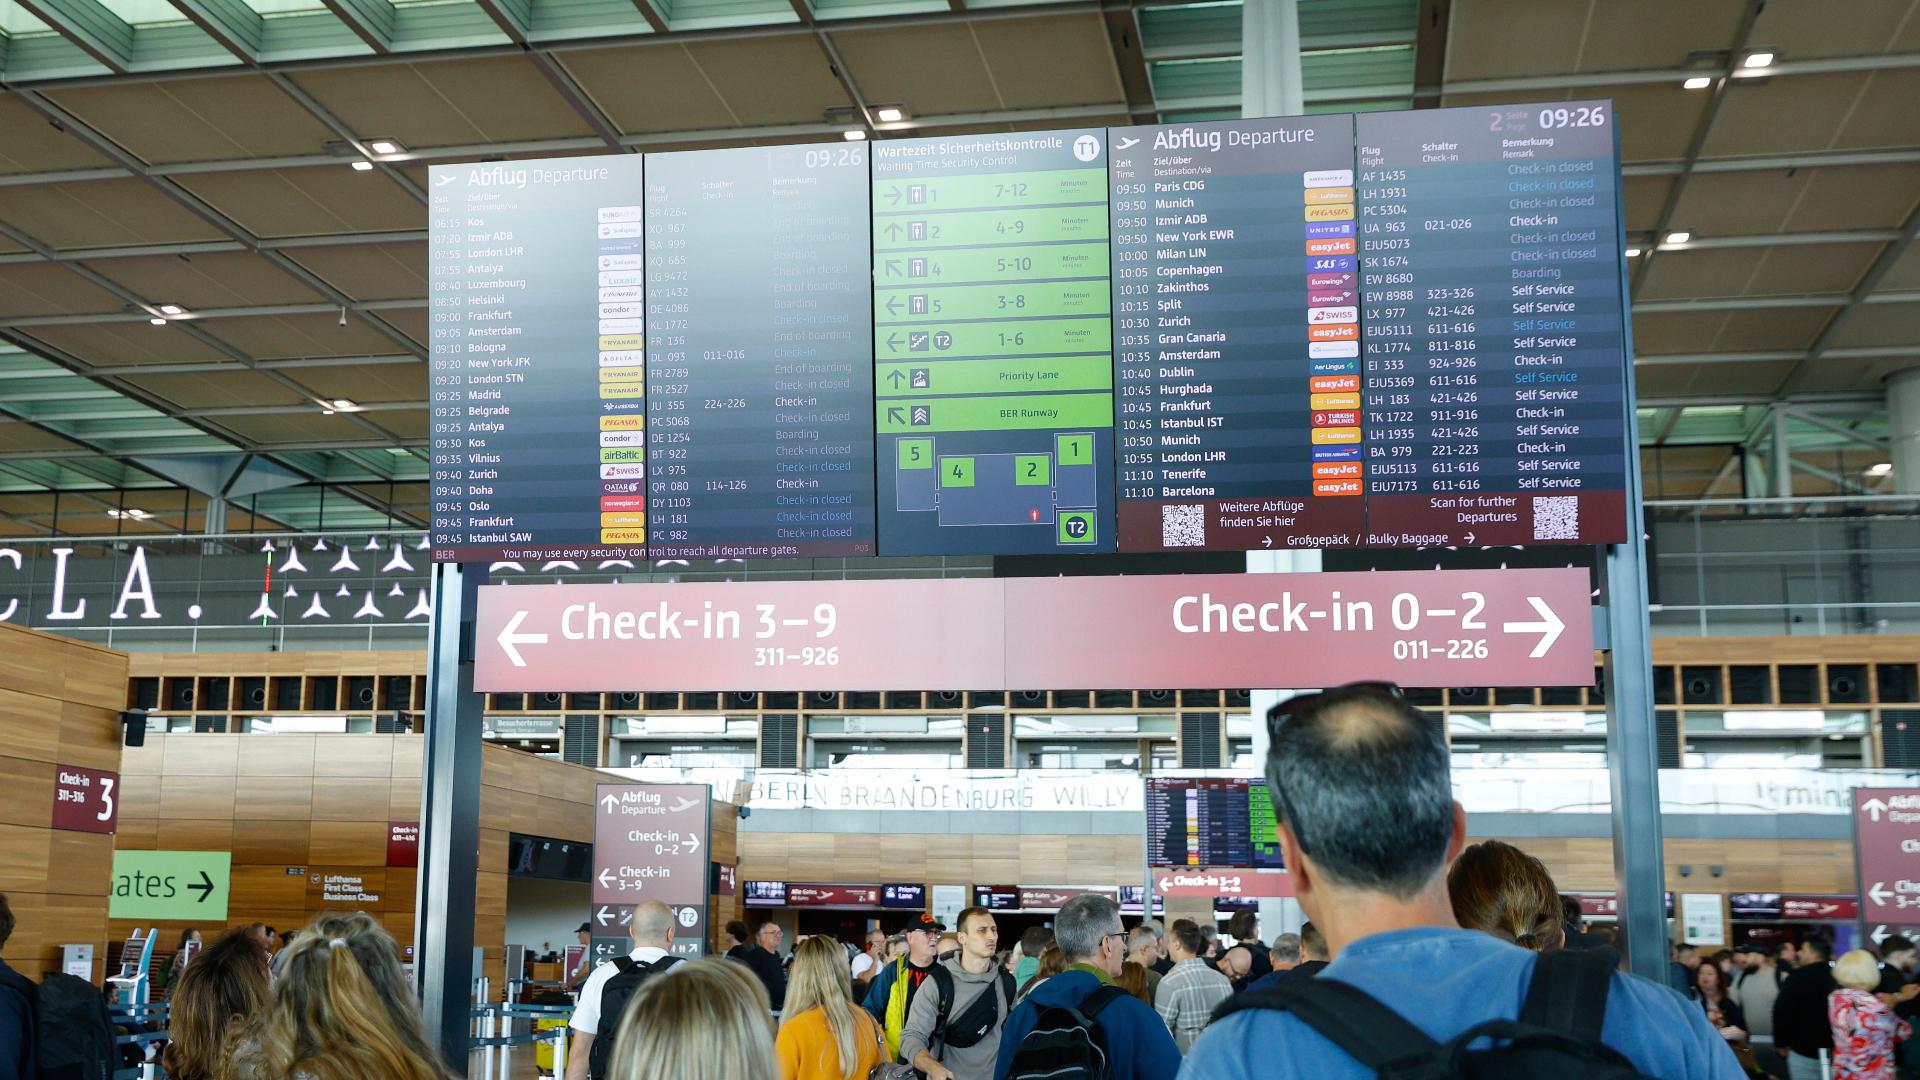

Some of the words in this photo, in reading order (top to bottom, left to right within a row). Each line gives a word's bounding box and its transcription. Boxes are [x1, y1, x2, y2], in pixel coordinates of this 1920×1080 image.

[1539, 107, 1604, 128] 09:26
[1153, 128, 1221, 151] Abflug
[1229, 128, 1314, 145] Departure
[1503, 138, 1553, 148] Bemerkung
[878, 145, 935, 158] Wartezeit
[940, 137, 1062, 154] Sicherheitskontrolle
[1078, 142, 1095, 155] T1
[1362, 147, 1380, 156] Flug
[1422, 142, 1458, 151] Schalter
[805, 150, 862, 168] 09:26
[878, 161, 912, 171] Waiting
[942, 158, 979, 169] Security
[983, 156, 1017, 165] Control
[1154, 157, 1192, 165] Ziel/über
[1423, 154, 1458, 162] Check-in
[468, 167, 527, 188] Abflug
[534, 168, 608, 185] Departure
[996, 184, 1028, 197] 7-12
[1117, 185, 1145, 194] 09:50
[1155, 182, 1180, 192] Paris
[1184, 181, 1204, 191] CDG
[931, 190, 936, 202] 1
[1155, 198, 1193, 209] Munich
[1156, 216, 1181, 226] Izmir
[1185, 215, 1207, 224] ADB
[932, 227, 940, 239] 2
[997, 221, 1024, 234] 4-9
[1157, 233, 1178, 243] New
[1182, 232, 1206, 241] York
[1210, 230, 1234, 239] EWR
[1311, 242, 1350, 251] easyJet
[1157, 250, 1185, 260] Milan
[1189, 248, 1206, 258] LIN
[932, 264, 941, 275] 4
[997, 258, 1031, 271] 5-10
[1157, 265, 1222, 278] Copenhagen
[1158, 283, 1209, 293] Zakinthos
[933, 300, 941, 312] 5
[998, 295, 1025, 308] 3-8
[1158, 300, 1181, 311] Split
[1158, 317, 1190, 327] Zurich
[936, 336, 950, 346] T2
[1000, 332, 1023, 346] 1-6
[1159, 334, 1183, 343] Gran
[1187, 332, 1226, 342] Canaria
[1159, 350, 1220, 360] Amsterdam
[1000, 372, 1034, 381] Priority
[1037, 371, 1059, 379] Lane
[1160, 368, 1194, 377] Dublin
[469, 391, 501, 400] Madrid
[1160, 384, 1212, 396] Hurghada
[469, 406, 509, 417] Belgrade
[1161, 401, 1211, 411] Frankfurt
[1000, 410, 1017, 418] BER
[1021, 409, 1058, 419] Runway
[469, 422, 504, 432] Antalya
[1161, 418, 1204, 428] Istanbul
[1208, 417, 1223, 427] IST
[1162, 435, 1200, 445] Munich
[605, 450, 639, 459] airBaltic
[911, 447, 919, 460] 5
[1072, 443, 1078, 456] 1
[469, 454, 500, 463] Vilnius
[1162, 452, 1201, 462] London
[1205, 451, 1226, 461] LHR
[469, 471, 497, 479] Zurich
[953, 465, 963, 478] 4
[1028, 463, 1036, 477] 2
[1125, 471, 1153, 480] 11:10
[1163, 469, 1206, 479] Tenerife
[652, 483, 665, 492] QR
[671, 482, 688, 491] 080
[706, 481, 747, 490] 114-126
[777, 479, 818, 489] Check-in
[1318, 483, 1358, 493] easyJet
[1372, 482, 1417, 492] EJU7173
[1433, 480, 1480, 490] 611-616
[1519, 479, 1539, 488] Self
[1542, 478, 1581, 488] Service
[469, 486, 493, 495] Doha
[1125, 488, 1153, 497] 11:10
[1163, 486, 1215, 496] Barcelona
[469, 502, 489, 511] Oslo
[1220, 503, 1259, 512] Weitere
[1263, 501, 1304, 512] Abflüge
[1431, 498, 1455, 507] Scan
[1459, 498, 1475, 507] for
[1478, 497, 1517, 506] further
[469, 517, 513, 526] Frankfurt
[1220, 517, 1253, 527] finden
[1257, 517, 1271, 526] Sie
[1275, 517, 1295, 526] hier
[1457, 512, 1517, 523] Departures
[1069, 522, 1084, 534] T2
[437, 535, 462, 543] 09:45
[470, 534, 507, 543] Istanbul
[510, 534, 532, 542] SAW
[1287, 535, 1349, 546] Großgepäck
[1370, 534, 1398, 545] Bulky
[1402, 533, 1448, 544] Baggage
[436, 551, 455, 559] BER
[503, 550, 521, 558] You
[545, 550, 561, 558] use
[563, 550, 588, 559] every
[591, 549, 627, 558] security
[680, 546, 705, 556] reach
[708, 546, 719, 555] all
[722, 544, 768, 555] departure
[771, 546, 799, 556] gates.
[1172, 591, 1374, 633] Check-in
[561, 601, 740, 640] Check-in
[60, 772, 90, 787] Check-in
[97, 778, 114, 821] 3
[622, 792, 661, 804] Abflug
[622, 806, 666, 815] Departure
[629, 830, 679, 841] Check-in
[619, 866, 670, 877] Check-in
[111, 869, 176, 898] ates
[325, 875, 361, 883] Lufthansa
[730, 868, 735, 889] 4
[1174, 876, 1218, 886] Check-in
[342, 884, 363, 892] Class
[898, 886, 920, 894] Priority
[358, 893, 378, 901] Class
[683, 912, 694, 922] T2
